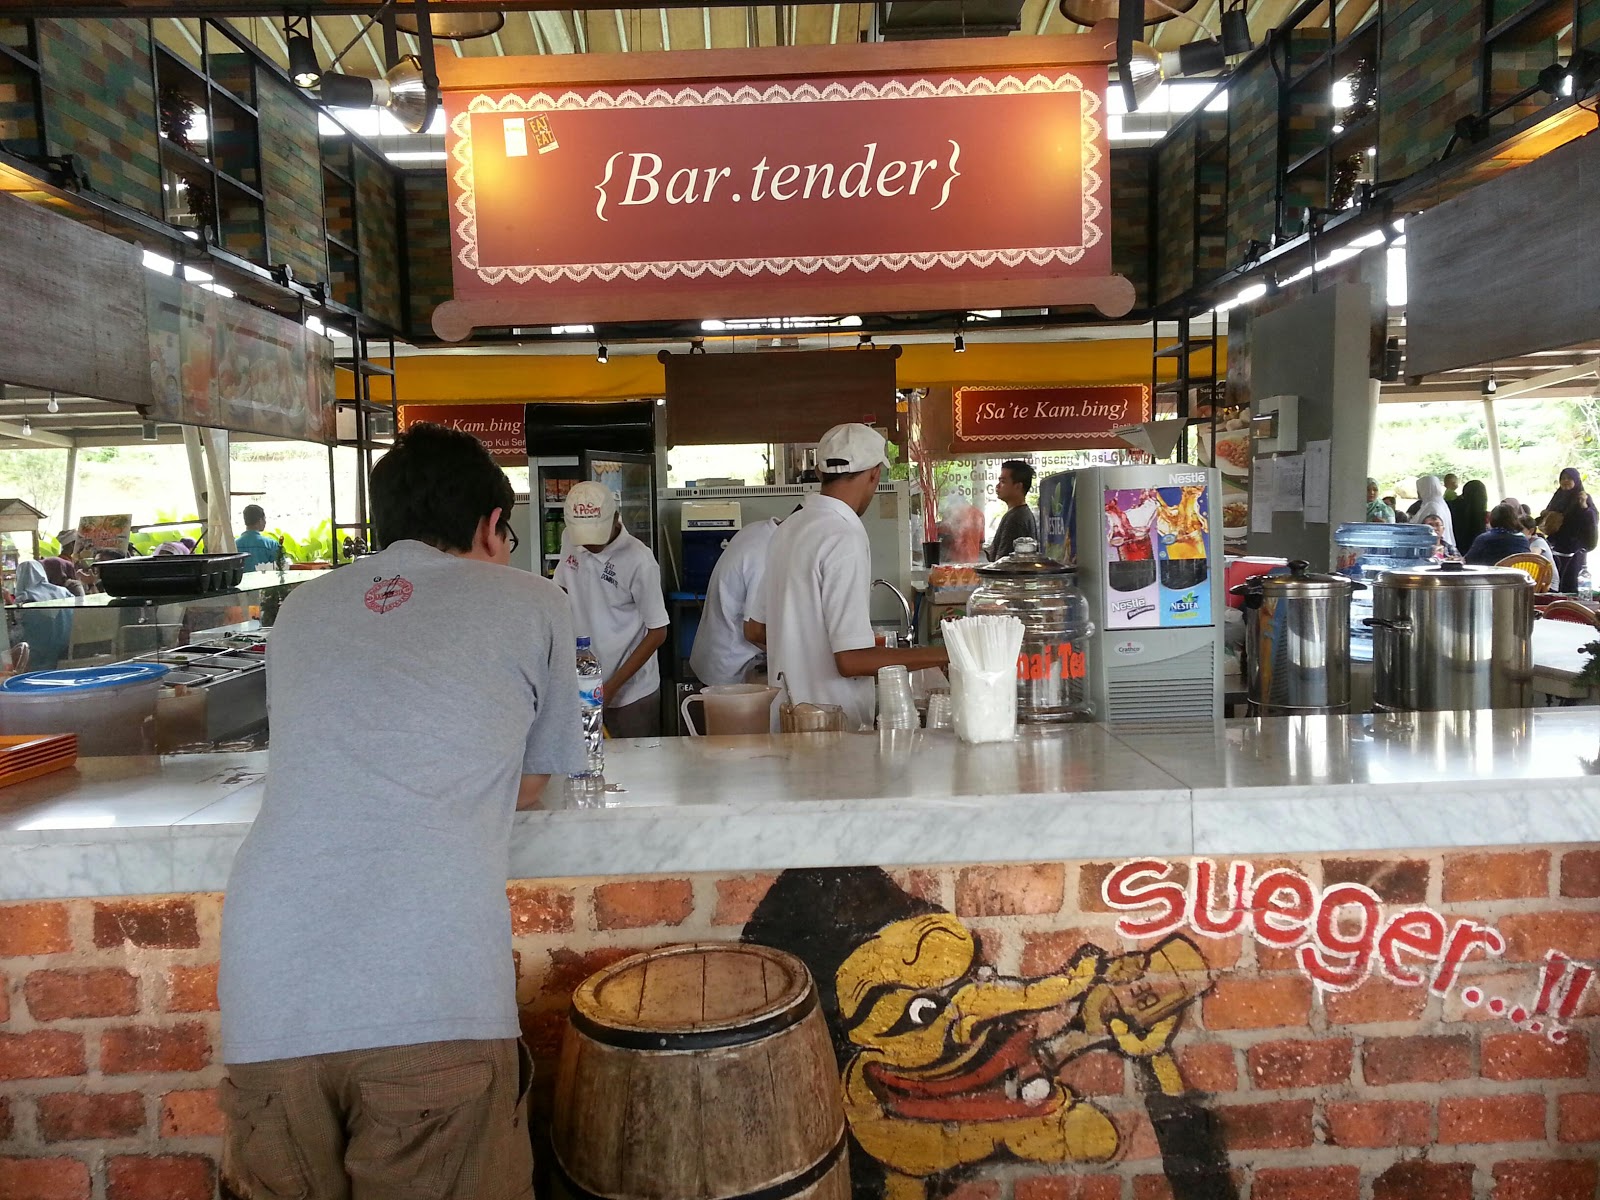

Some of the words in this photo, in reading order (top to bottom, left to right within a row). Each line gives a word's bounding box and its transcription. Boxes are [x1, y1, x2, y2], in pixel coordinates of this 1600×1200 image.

[595, 139, 961, 221] {Bar.tender}
[1033, 399, 1128, 421] Kam.bing}
[970, 469, 998, 481] Gulai
[958, 485, 977, 497] Sop
[1170, 602, 1199, 610] NESTEA
